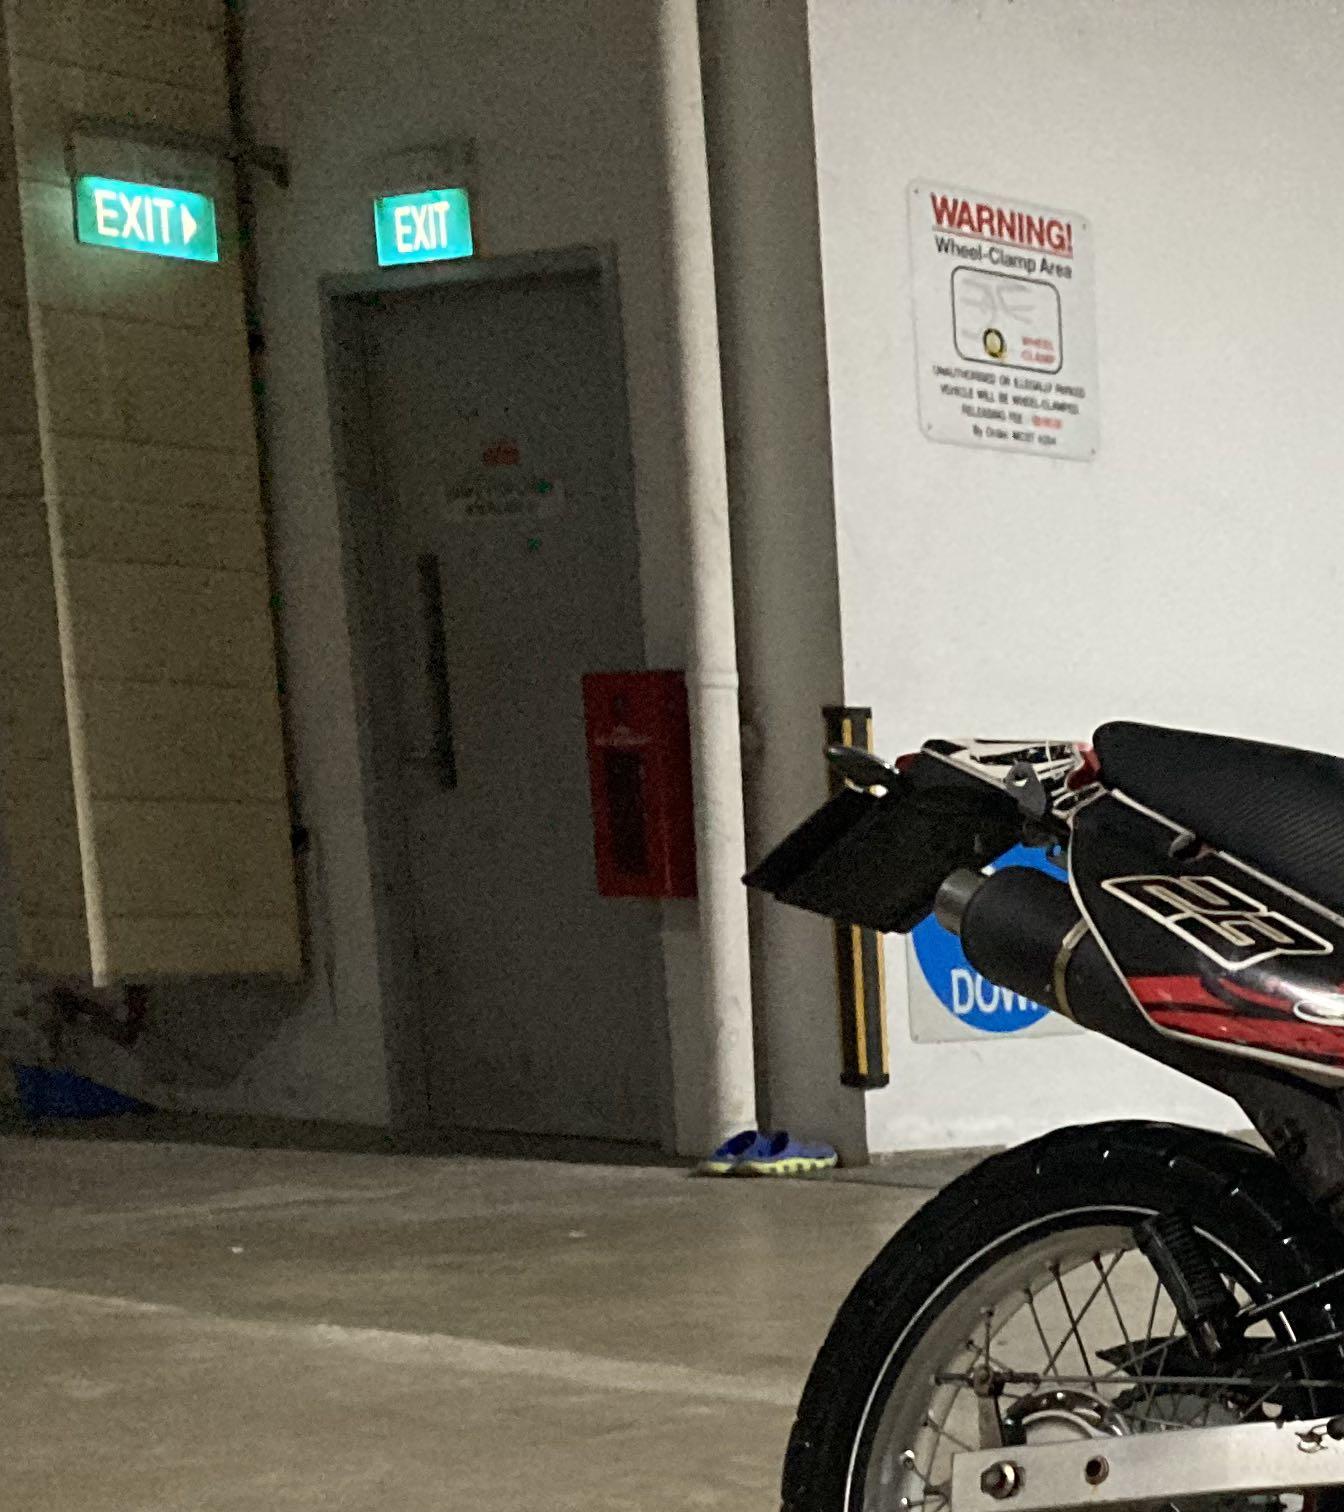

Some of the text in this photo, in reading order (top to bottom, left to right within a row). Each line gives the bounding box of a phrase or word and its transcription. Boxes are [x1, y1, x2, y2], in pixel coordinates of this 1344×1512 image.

[94, 189, 175, 244] EXIT
[394, 201, 450, 253] EXIT
[930, 191, 1073, 251] WARNING!
[934, 234, 1073, 279] Wheel-Clamp Area
[951, 968, 1038, 1014] DOW
